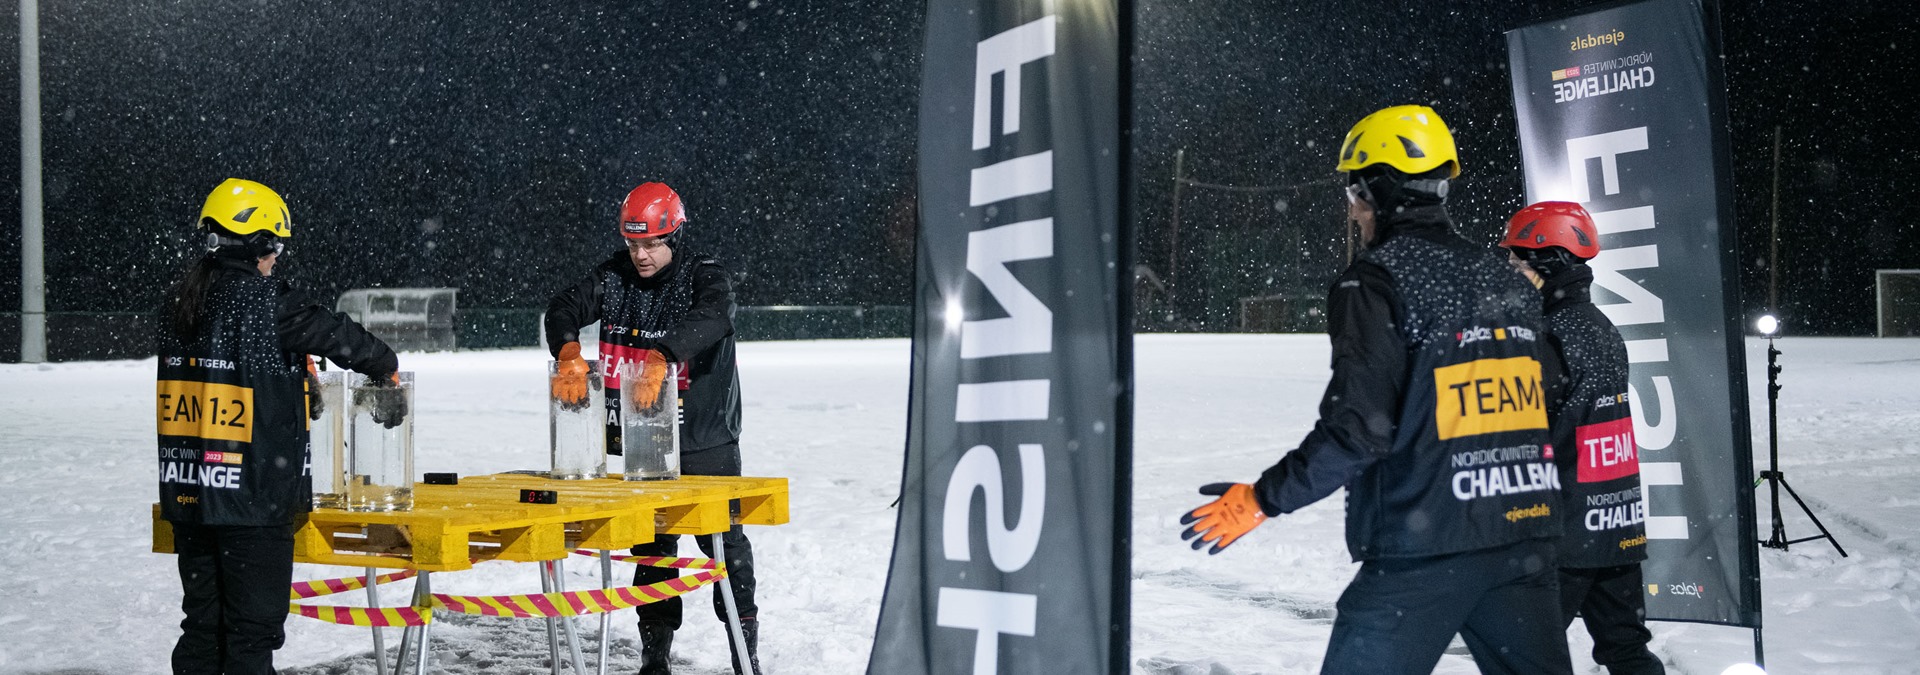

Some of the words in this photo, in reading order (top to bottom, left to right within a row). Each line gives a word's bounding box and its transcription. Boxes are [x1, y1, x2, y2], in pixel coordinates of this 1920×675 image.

[198, 357, 236, 370] TGERA
[209, 397, 246, 428] 1:2
[1449, 375, 1540, 417] TEAM
[1583, 431, 1634, 468] TEAM
